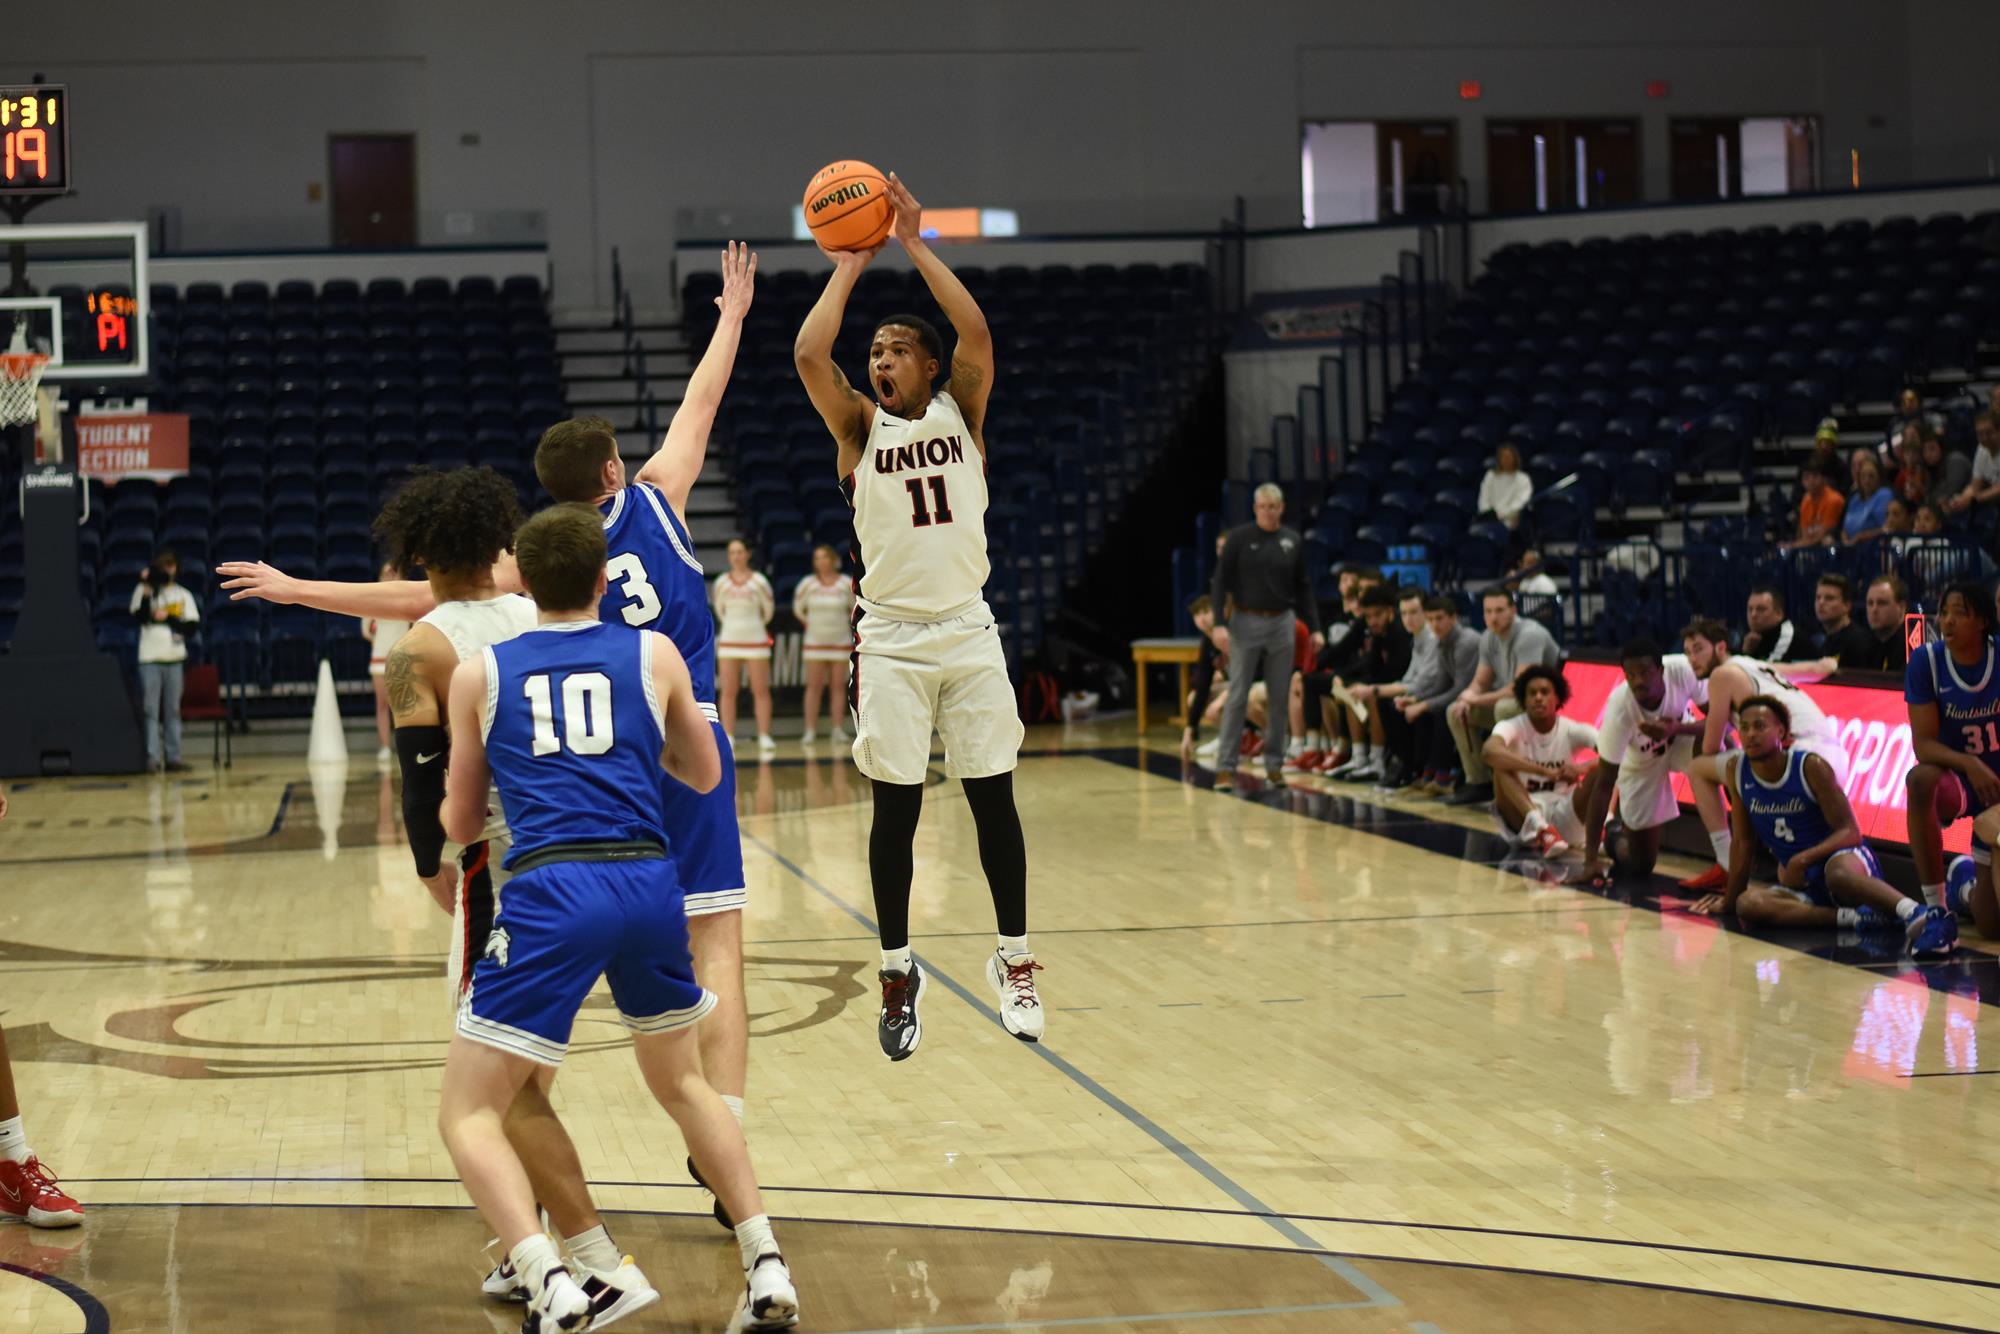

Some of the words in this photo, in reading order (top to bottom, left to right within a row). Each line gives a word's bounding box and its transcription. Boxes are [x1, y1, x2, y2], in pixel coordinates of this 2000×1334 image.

[5, 128, 47, 180] 19
[811, 181, 870, 214] Wilson
[875, 435, 964, 474] UNION
[905, 474, 953, 528] 11
[606, 551, 663, 628] 3
[523, 671, 615, 758] 10
[1945, 697, 2000, 719] Huntsvill
[1961, 721, 2000, 755] 31
[1749, 797, 1806, 815] Huntsville
[1774, 817, 1795, 842] 4
